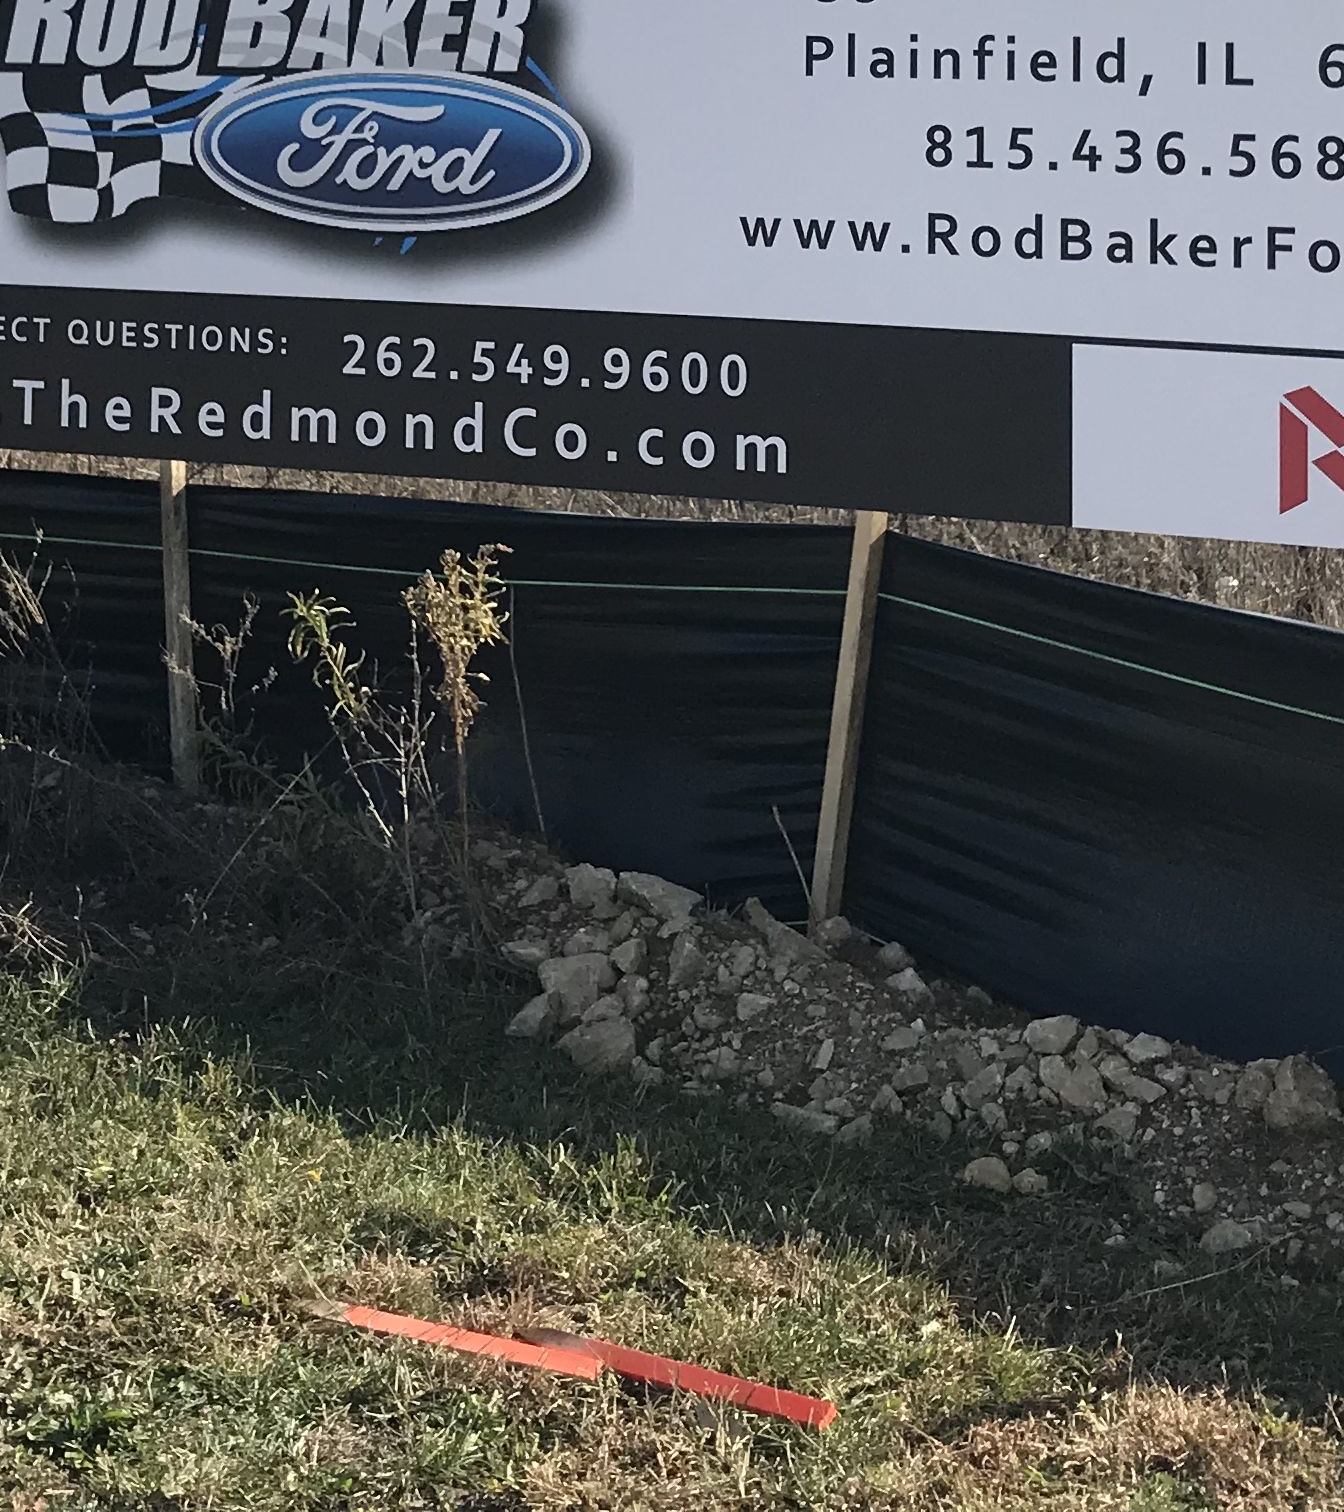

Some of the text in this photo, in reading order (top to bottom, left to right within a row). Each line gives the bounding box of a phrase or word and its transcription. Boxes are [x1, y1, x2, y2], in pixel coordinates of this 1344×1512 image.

[806, 33, 1153, 96] Plainfield,
[1198, 42, 1253, 86] IL
[277, 97, 502, 194] Ford
[68, 320, 286, 354] QUESTIONS:
[342, 334, 747, 398] 262.549.9600
